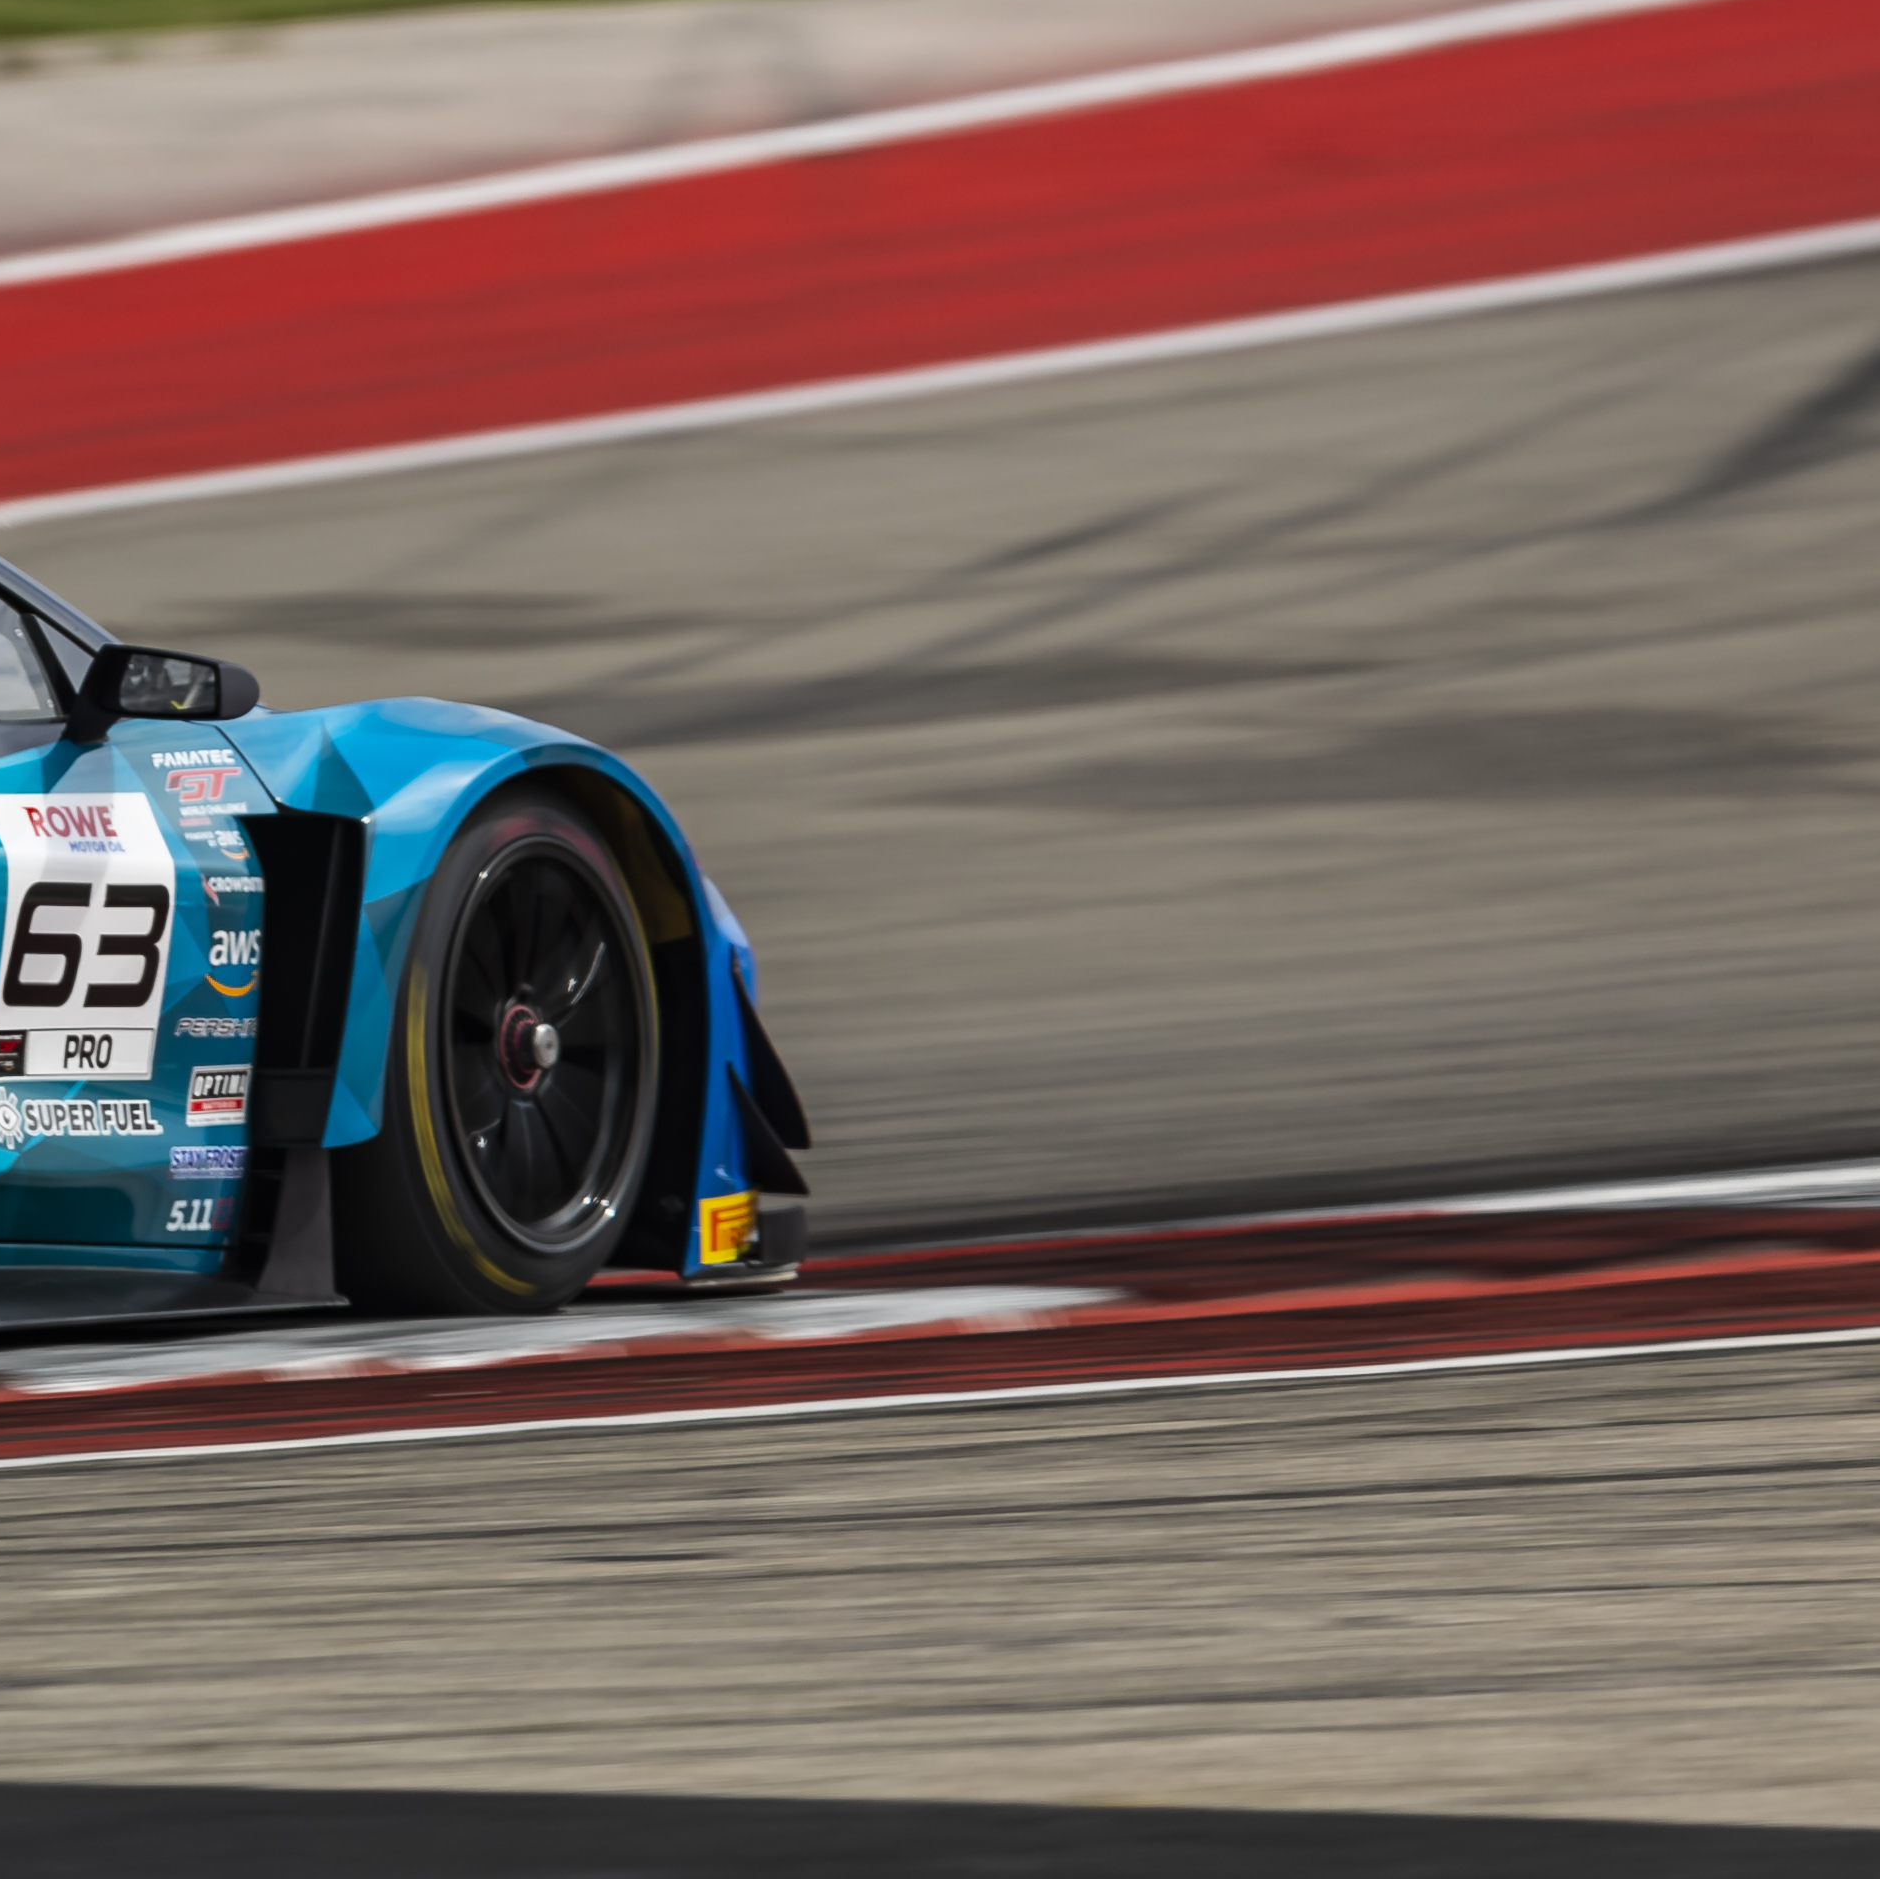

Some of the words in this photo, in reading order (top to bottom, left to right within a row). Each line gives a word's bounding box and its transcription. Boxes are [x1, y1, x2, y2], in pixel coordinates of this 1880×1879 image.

[151, 749, 236, 768] FANATEC
[22, 806, 118, 837] ROWE
[68, 841, 106, 853] MOTOR
[108, 841, 126, 853] OIL
[2, 881, 170, 1007] 63
[209, 929, 261, 966] aws
[63, 1034, 113, 1068] PRO
[23, 1101, 98, 1133] SUPER
[99, 1101, 158, 1133] FUEL
